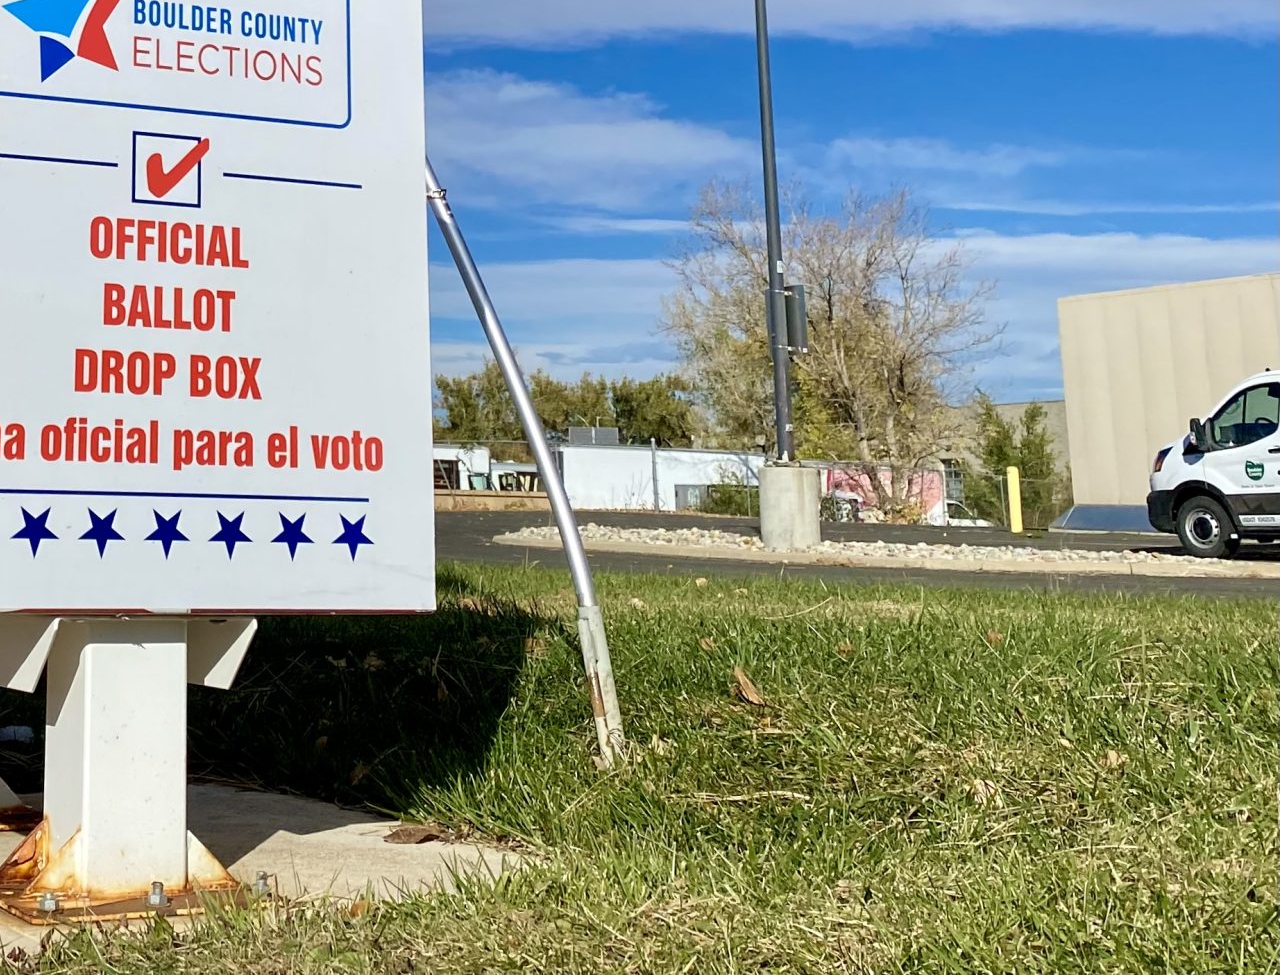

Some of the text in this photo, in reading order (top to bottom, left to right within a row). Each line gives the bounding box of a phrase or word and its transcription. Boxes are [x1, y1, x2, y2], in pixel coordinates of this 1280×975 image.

[240, 11, 323, 45] COUNTY
[133, 35, 323, 87] ELECTIONS
[89, 215, 249, 269] OFFICIAL
[103, 283, 236, 333] BALLOT
[74, 348, 263, 401] DROP BOX
[40, 417, 159, 465] oficial
[172, 428, 255, 471] para
[267, 425, 298, 468] el
[310, 430, 384, 472] voto
